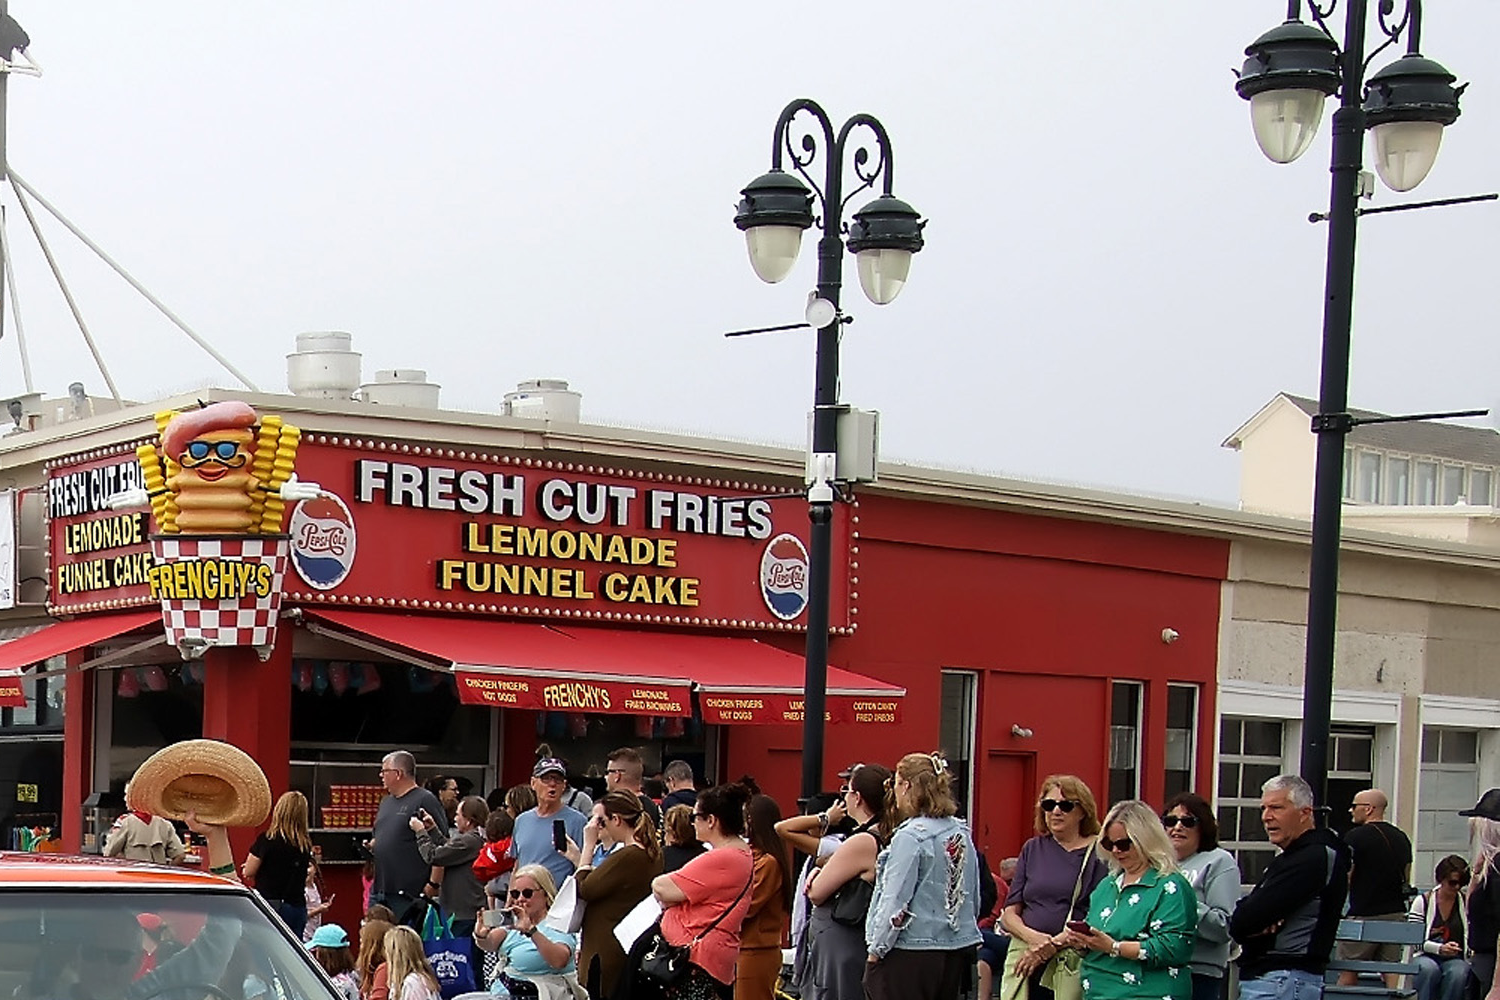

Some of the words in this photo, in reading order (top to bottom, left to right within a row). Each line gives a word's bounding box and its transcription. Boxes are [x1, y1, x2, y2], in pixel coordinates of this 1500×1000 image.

[49, 471, 88, 518] FRESH
[91, 465, 116, 511] CUT
[360, 459, 525, 517] FRESH
[542, 479, 637, 526] CUT
[651, 489, 773, 540] FRIES
[66, 512, 142, 555] LEMONADE
[468, 522, 678, 568] LEMONADE
[58, 558, 110, 595] FUNNEL
[113, 552, 154, 588] CAKE
[148, 558, 272, 601] FRENCHY'S
[442, 559, 595, 599] FUNNEL
[605, 572, 700, 607] CAKE
[465, 678, 497, 689] CHICKEN
[543, 683, 611, 709] FRENCHY'S
[706, 698, 734, 708] CHICKEN
[733, 711, 753, 720] DOGS
